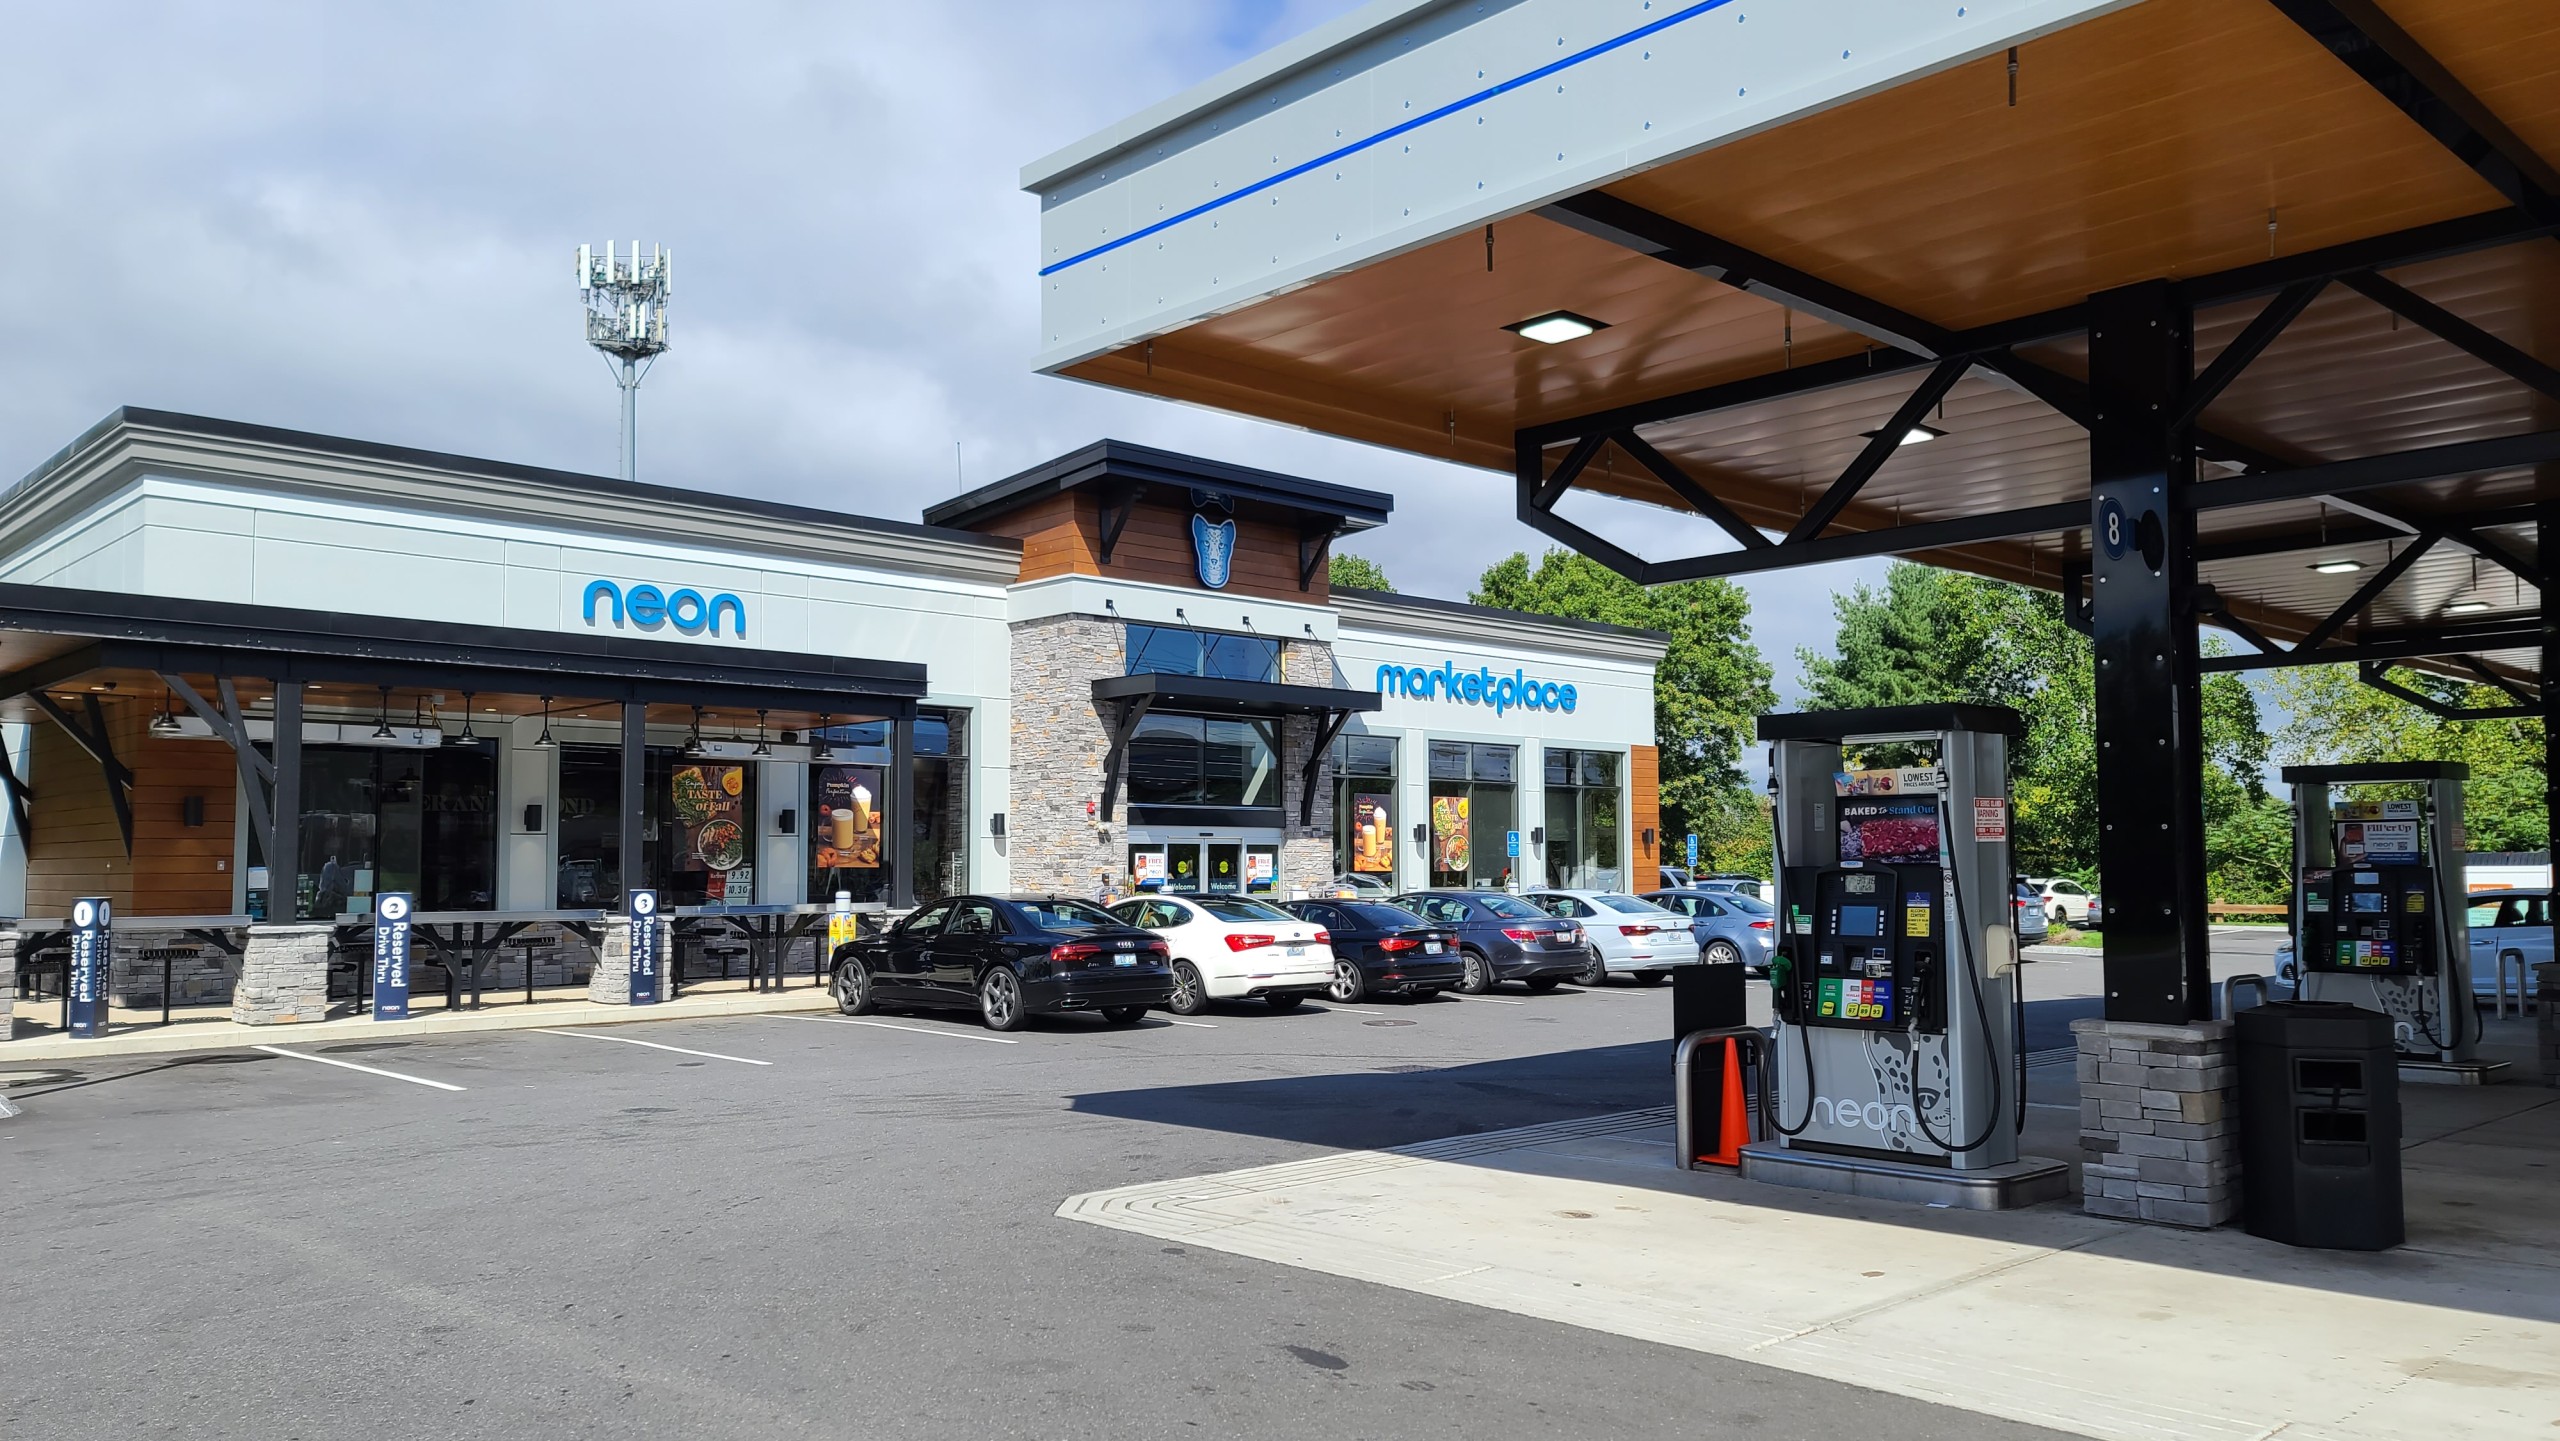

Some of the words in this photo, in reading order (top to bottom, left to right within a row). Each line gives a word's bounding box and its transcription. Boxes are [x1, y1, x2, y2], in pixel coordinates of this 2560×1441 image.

[2108, 512, 2120, 545] 8
[583, 580, 746, 634] neon
[1377, 660, 1578, 715] marketplace
[1903, 772, 1934, 782] LOWEST
[687, 790, 723, 800] TASTE
[695, 802, 707, 811] of
[709, 802, 731, 811] Fall
[1844, 807, 1878, 816] BAKED
[1879, 807, 1888, 815] to
[1889, 805, 1915, 814] Stand
[1917, 805, 1935, 814] Out
[2367, 824, 2383, 832] Fill
[2398, 824, 2411, 832] Up
[731, 870, 750, 880] 9.92
[1169, 882, 1196, 890] Welcome
[1210, 882, 1237, 890] Welcome
[389, 903, 399, 914] 2
[640, 898, 648, 909] 3
[378, 926, 391, 955] Drive
[632, 921, 641, 946] Drive
[643, 916, 655, 976] Reserved
[71, 934, 80, 966] Drive
[391, 922, 408, 988] Reserved
[632, 948, 642, 972] Thru
[79, 930, 94, 1002] Reserved
[102, 929, 110, 1001] Reserved
[377, 957, 389, 983] Thru
[70, 968, 79, 998] Thru
[1810, 1096, 1916, 1133] neon
